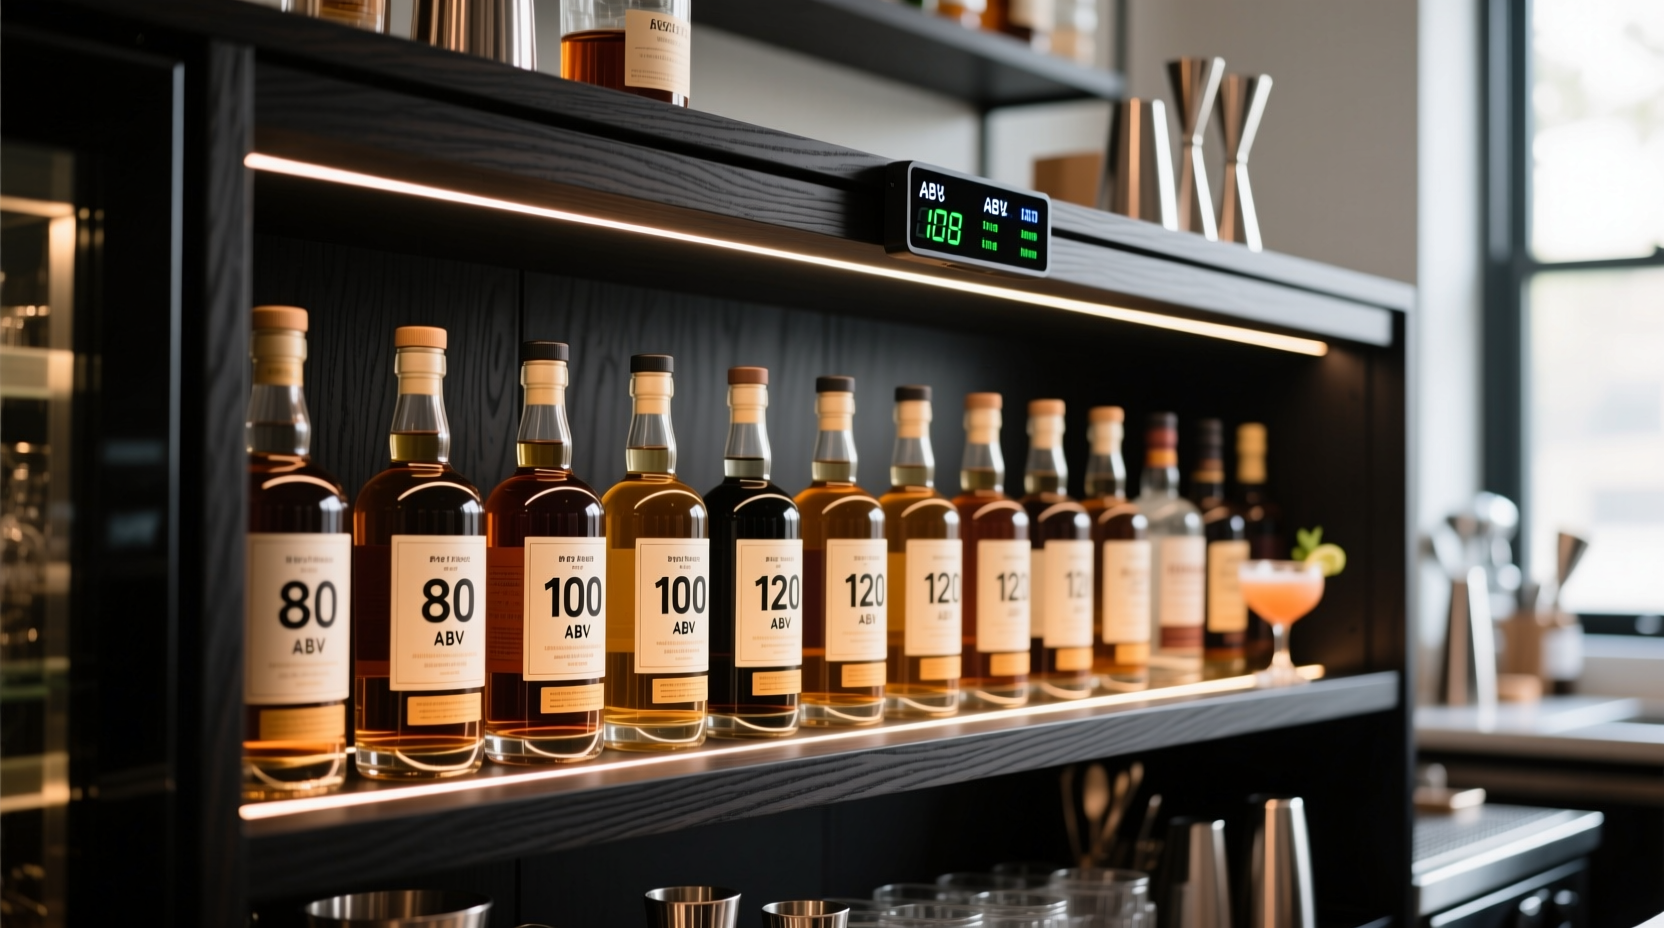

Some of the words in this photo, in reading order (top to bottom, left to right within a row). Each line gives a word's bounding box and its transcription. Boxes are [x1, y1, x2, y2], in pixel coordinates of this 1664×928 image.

[926, 208, 963, 246] 108
[278, 580, 337, 629] 80
[421, 578, 475, 623] 80
[544, 576, 602, 618] 100
[655, 575, 706, 614] 100
[754, 574, 800, 611] 120
[845, 573, 884, 608] 120
[434, 630, 465, 646] ABV
[564, 624, 591, 639] ABV
[672, 620, 696, 635] ABV
[770, 617, 792, 629] ABV
[292, 638, 326, 655] ABV
